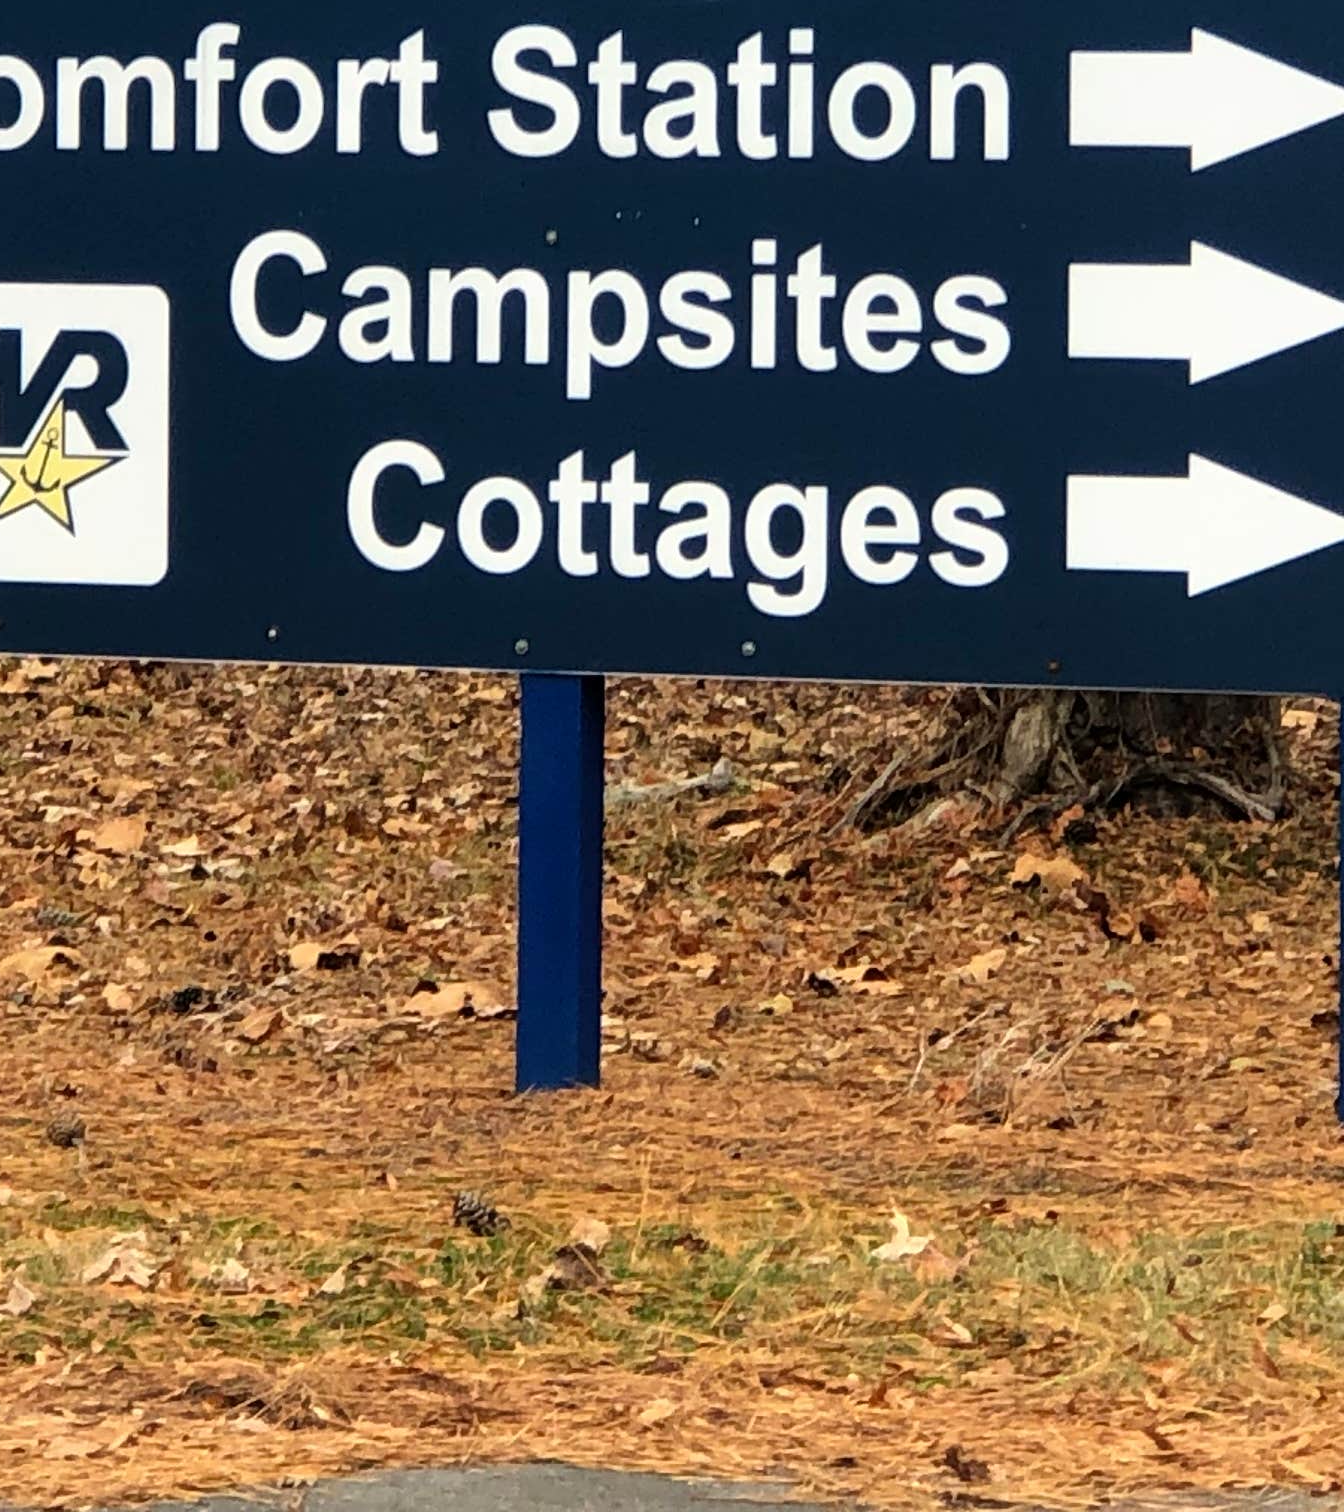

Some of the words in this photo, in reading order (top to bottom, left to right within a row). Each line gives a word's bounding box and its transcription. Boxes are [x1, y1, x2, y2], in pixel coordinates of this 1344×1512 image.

[487, 24, 1010, 161] Station
[230, 229, 1011, 399] Campsites
[347, 439, 1009, 617] Cottages
